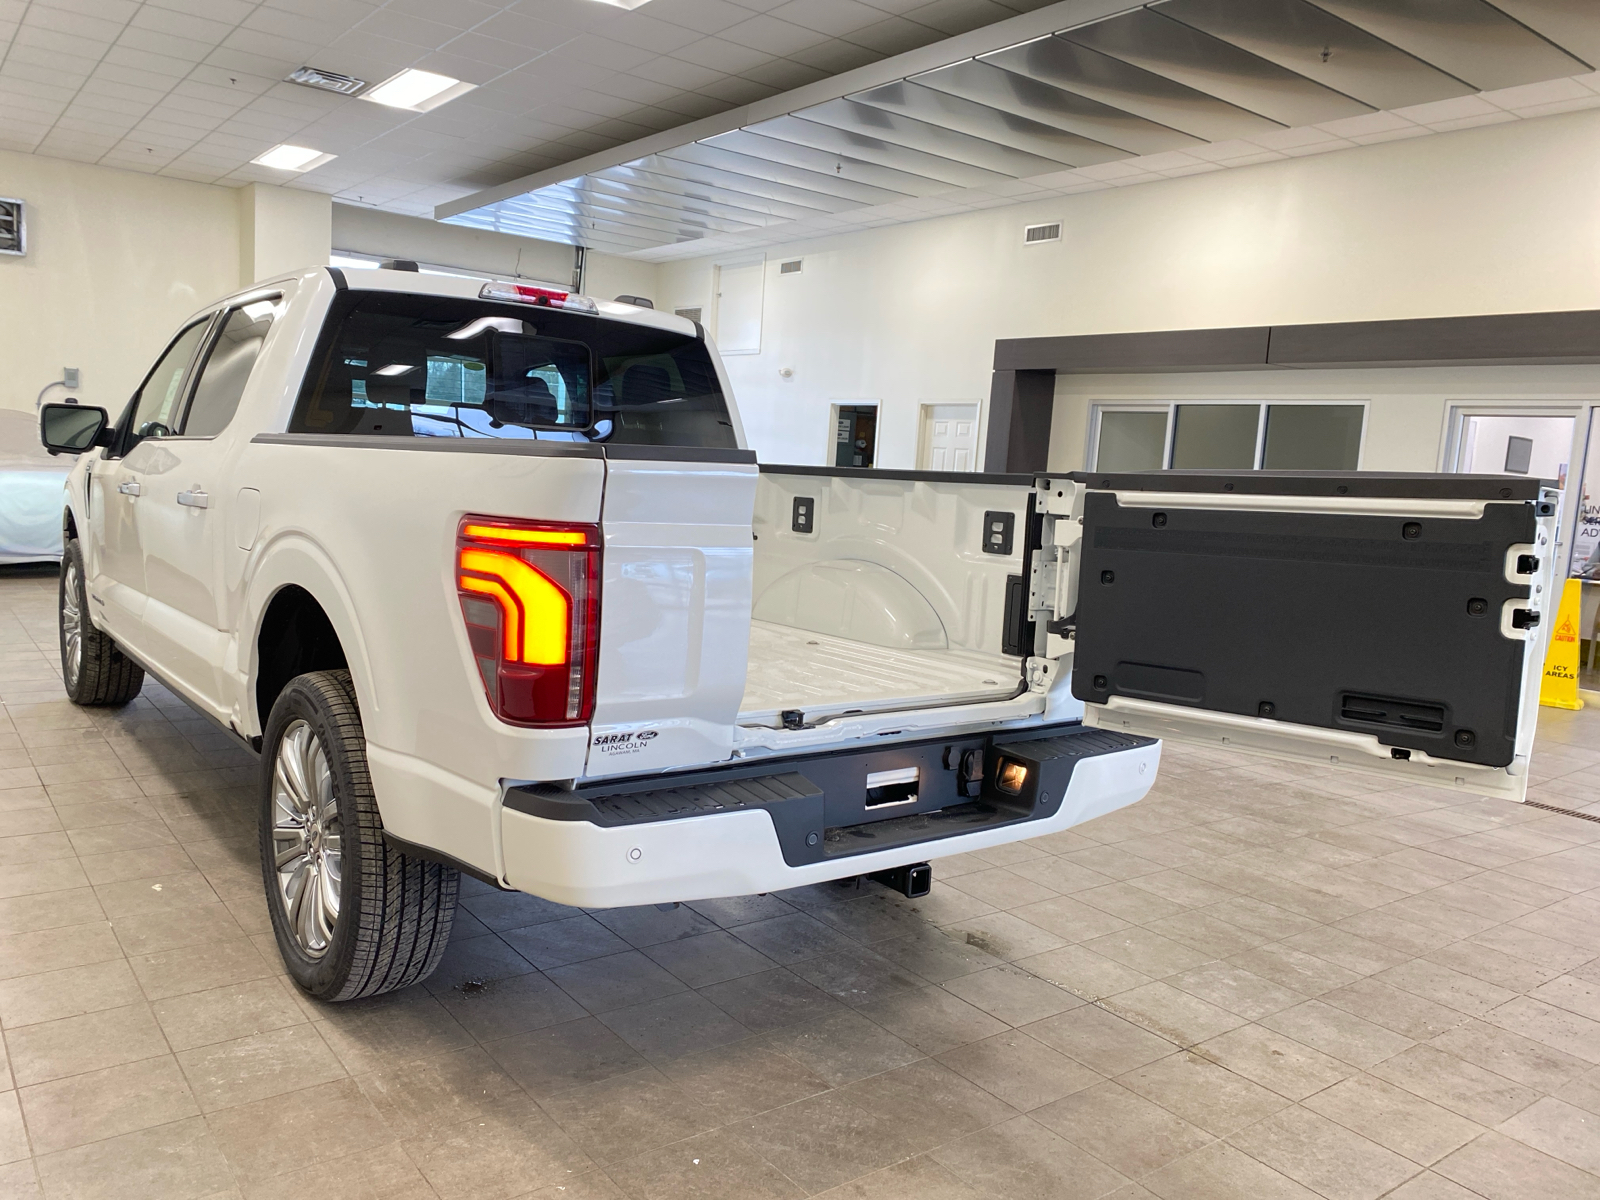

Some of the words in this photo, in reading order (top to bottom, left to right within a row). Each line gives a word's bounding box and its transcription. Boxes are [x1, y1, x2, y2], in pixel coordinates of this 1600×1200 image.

[1584, 505, 1600, 514] LIN
[1580, 528, 1600, 537] AD
[1545, 671, 1575, 679] AREAS
[593, 733, 634, 745] SARAT
[601, 741, 648, 752] LINCOLN
